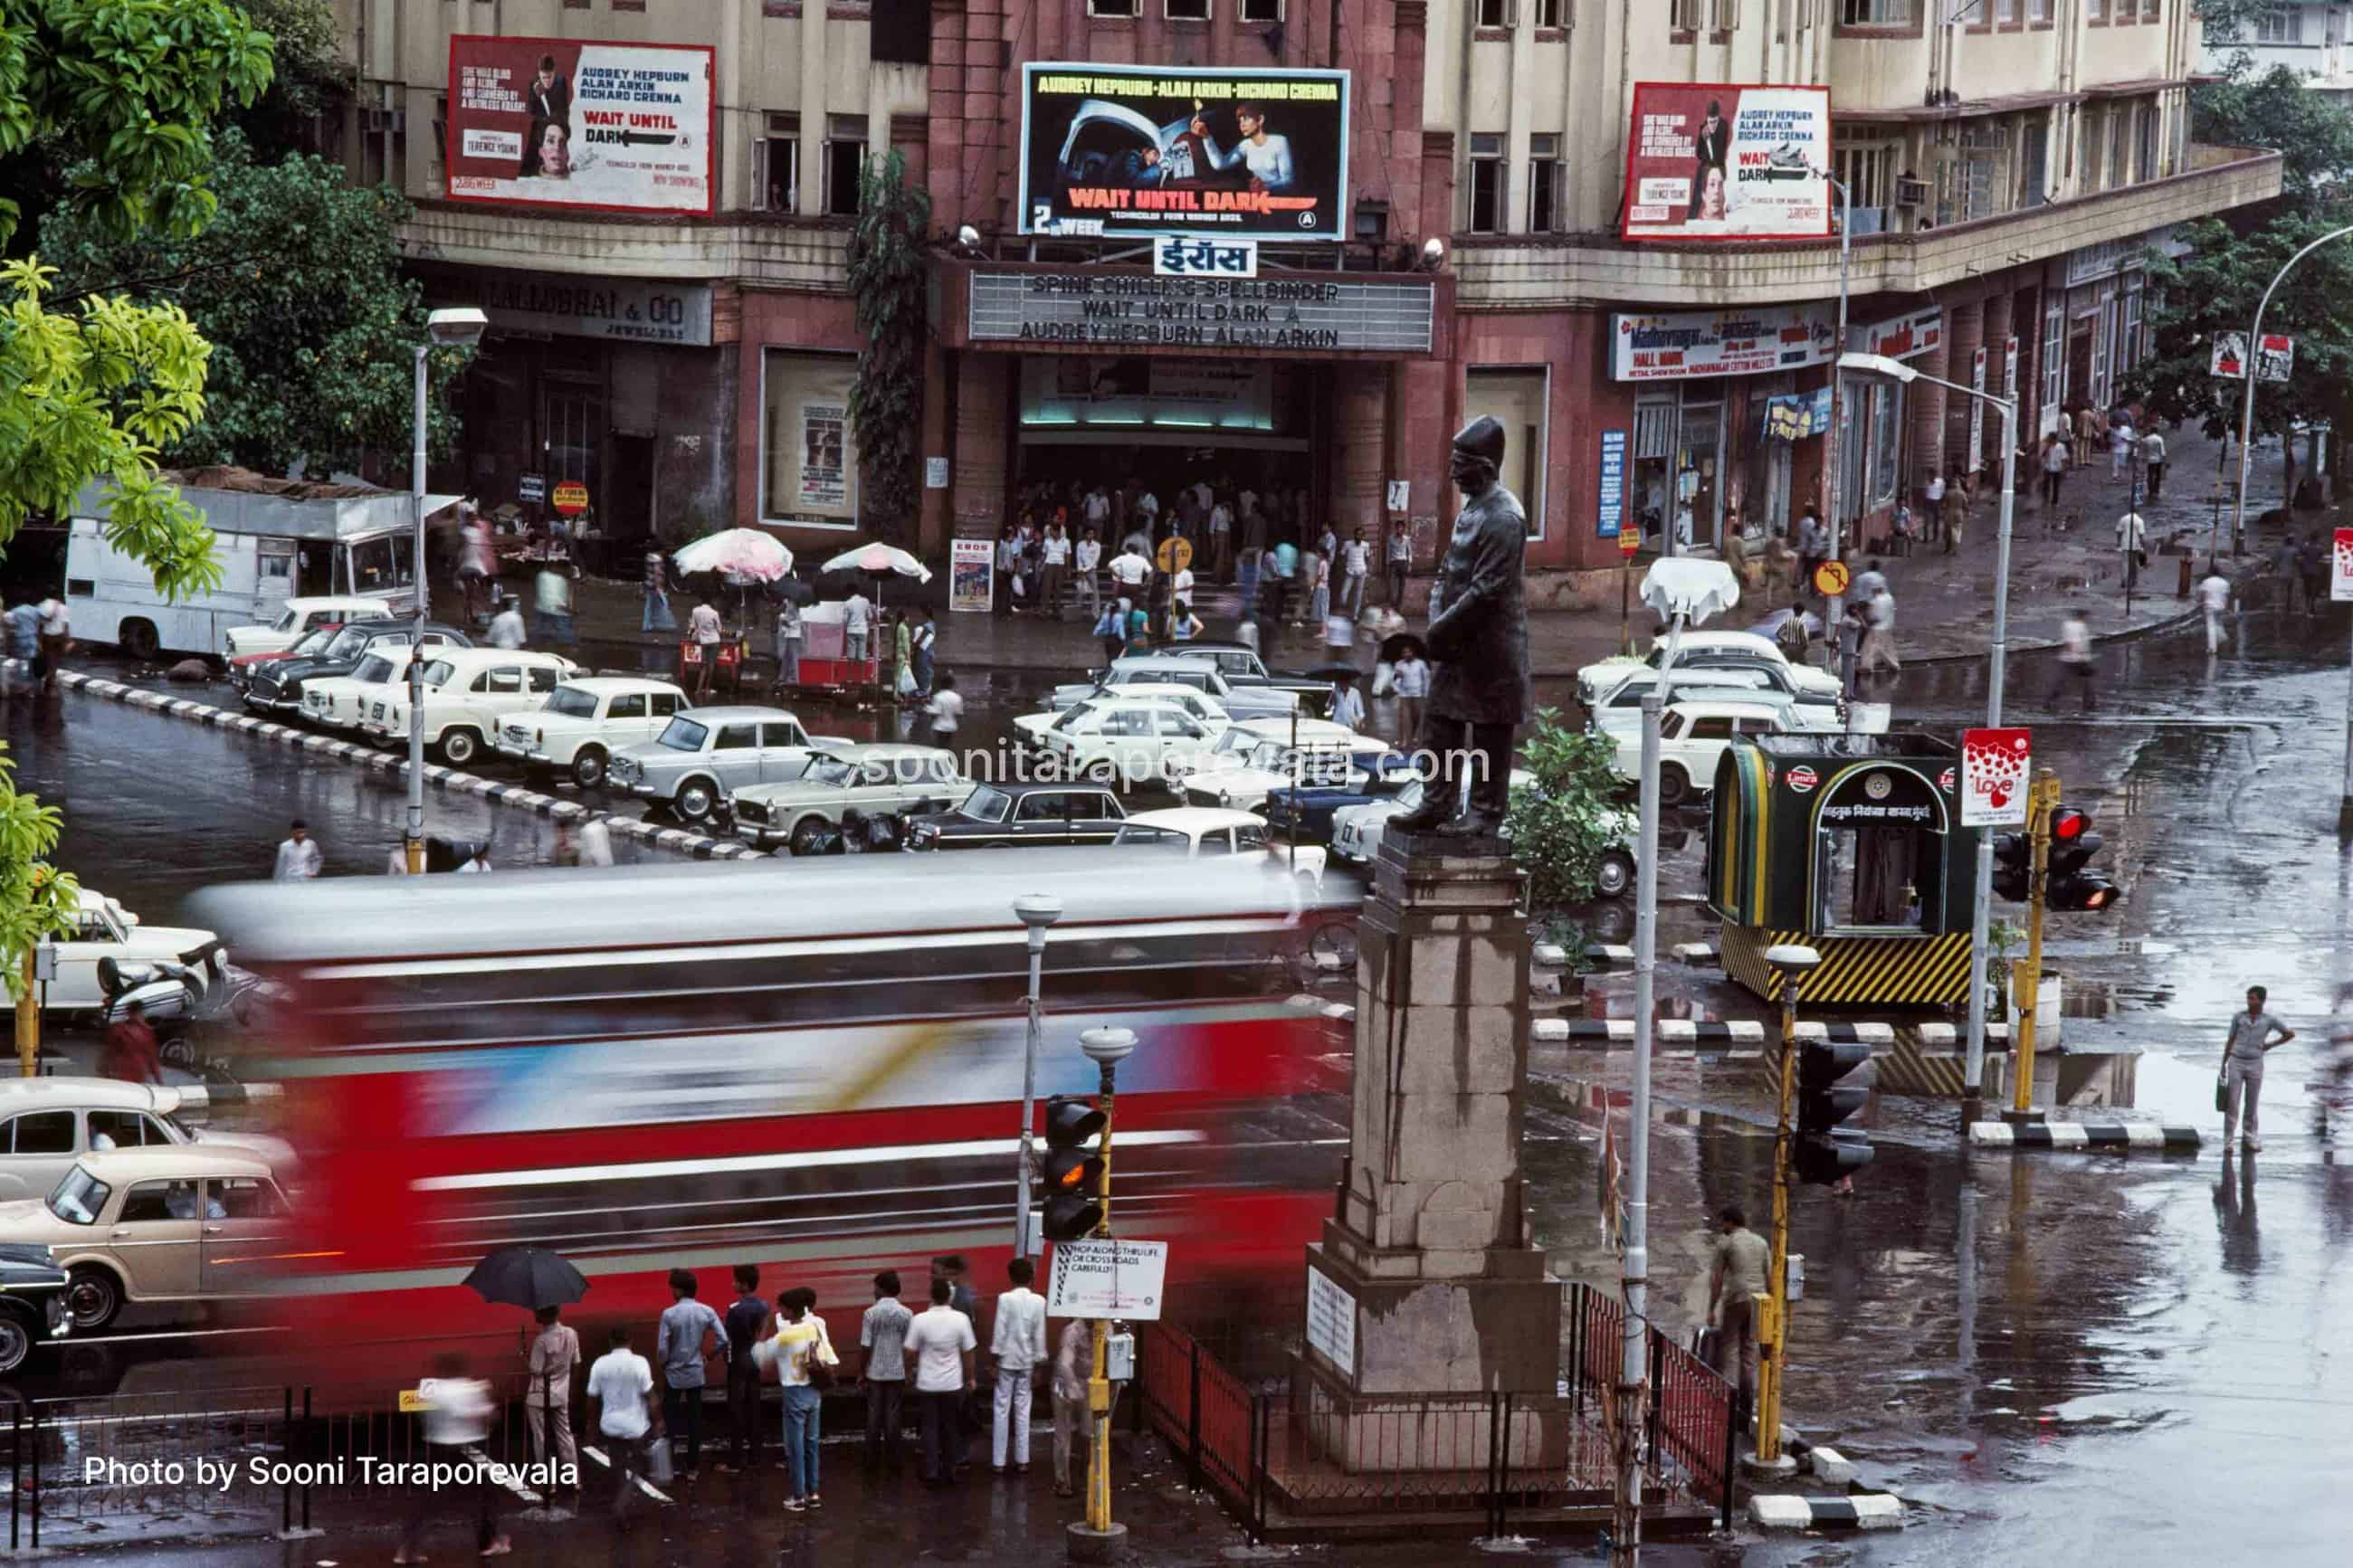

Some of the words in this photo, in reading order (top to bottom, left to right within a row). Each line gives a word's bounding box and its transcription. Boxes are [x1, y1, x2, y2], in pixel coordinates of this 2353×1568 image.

[581, 67, 629, 80] AUDREY
[633, 70, 689, 82] HEPBURN
[581, 78, 614, 89] ALAN
[618, 80, 654, 91] ARKIN
[1038, 76, 1093, 93] AUDREY
[1094, 78, 1153, 96] HEPBURN
[1158, 81, 1192, 98] ALAN
[1193, 81, 1232, 99] ARKIN
[1236, 82, 1289, 100] RICHARD
[1290, 83, 1338, 100] CRENNA
[579, 89, 631, 101] RICHARD
[634, 91, 681, 104] CRENNA
[584, 109, 624, 126] WAIT
[629, 113, 678, 129] UNTIL
[1739, 109, 1773, 119] AUDREY
[1739, 120, 1764, 129] ALAN
[1766, 120, 1793, 129] ARKIN
[1738, 130, 1777, 141] RICHARD
[1779, 130, 1813, 141] CRENNA
[1739, 151, 1769, 165] WAIT
[1068, 187, 1130, 208] WAIT
[1135, 190, 1198, 211] UNTIL
[1204, 191, 1270, 214] DARK
[1059, 220, 1103, 237] WEEK
[1161, 239, 1251, 272] ईरॉस
[1033, 275, 1093, 294] SPINE
[1205, 280, 1339, 301] SPELLBINDER
[1081, 299, 1134, 318] WAIT
[1144, 301, 1206, 319] UNTIL
[1215, 303, 1270, 322] DARK
[1284, 306, 1300, 324] A
[1020, 321, 1100, 340] AUDREY
[1106, 324, 1203, 344] HEPBURN
[1215, 327, 1270, 345] ALAN
[1274, 328, 1338, 347] ARKIN
[957, 543, 988, 551] EROS
[1976, 776, 2014, 794] Love
[1072, 1255, 1084, 1263] OR
[1086, 1256, 1110, 1264] CROSS
